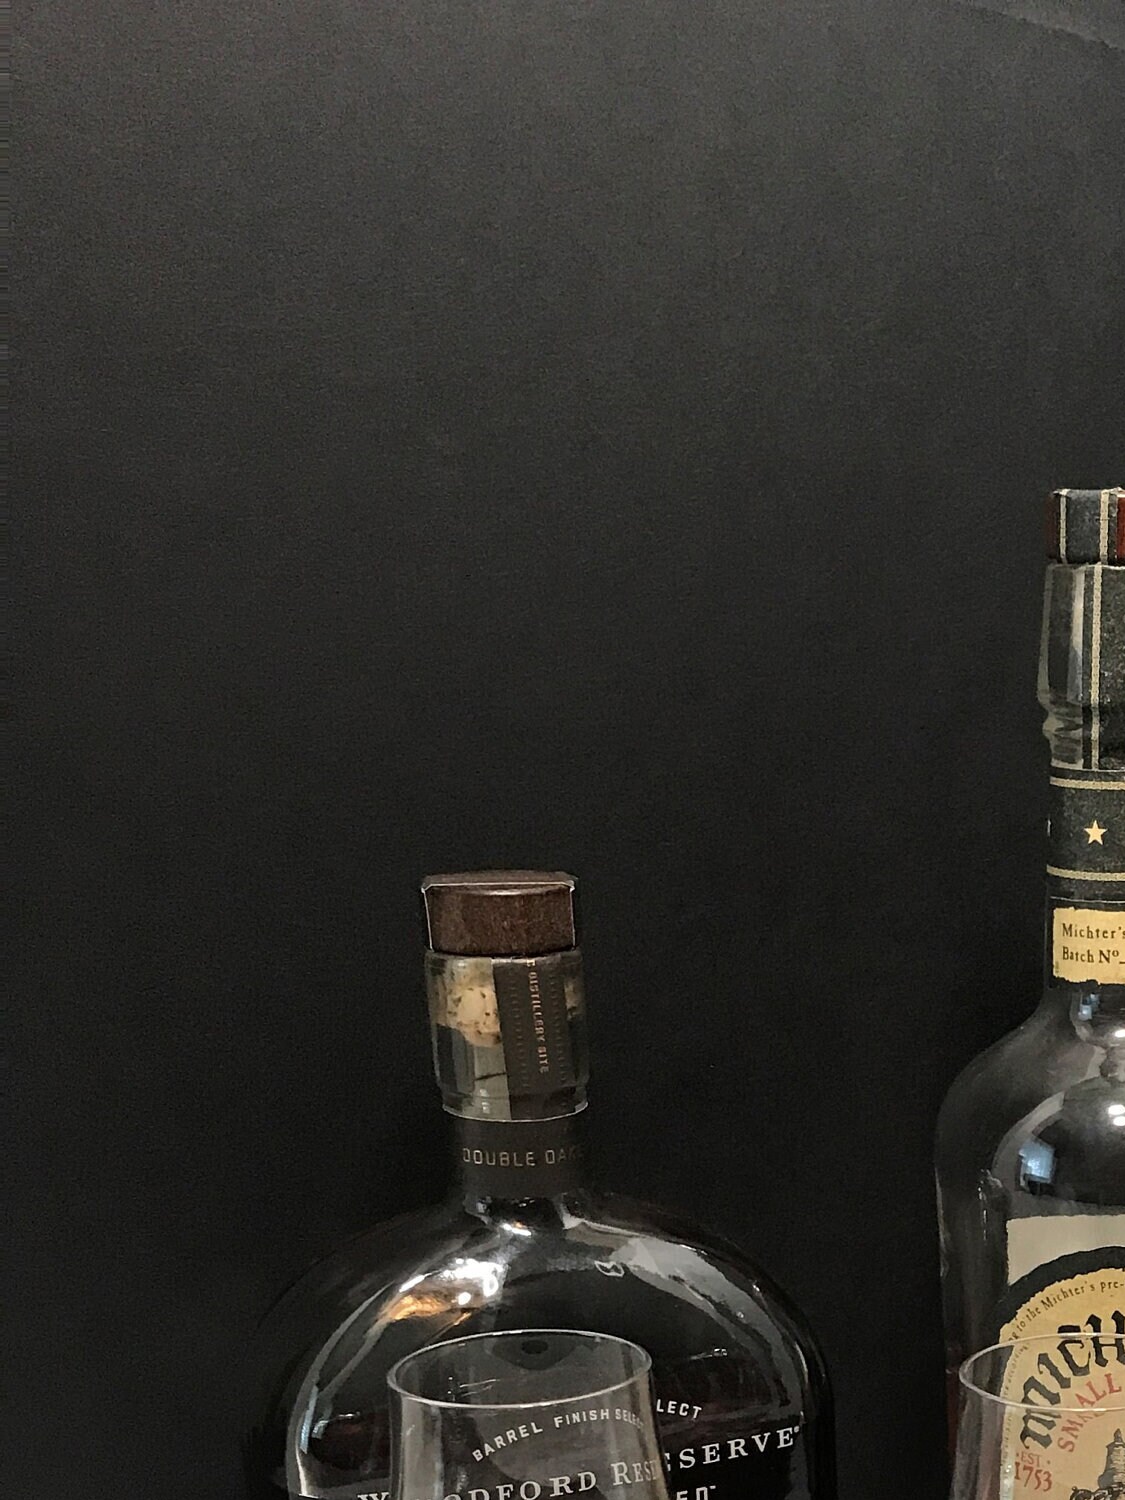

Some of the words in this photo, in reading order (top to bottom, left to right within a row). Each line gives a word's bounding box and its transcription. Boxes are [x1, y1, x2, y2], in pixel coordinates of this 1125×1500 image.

[1062, 946, 1095, 963] Batch
[462, 1148, 536, 1167] DOUBLE
[1025, 1307, 1042, 1322] the
[1041, 1281, 1096, 1310] Michter's
[1057, 1372, 1123, 1453] SMALL
[471, 1422, 543, 1462] BARREL
[554, 1408, 610, 1428] FINISH
[1014, 1461, 1052, 1491] 1753
